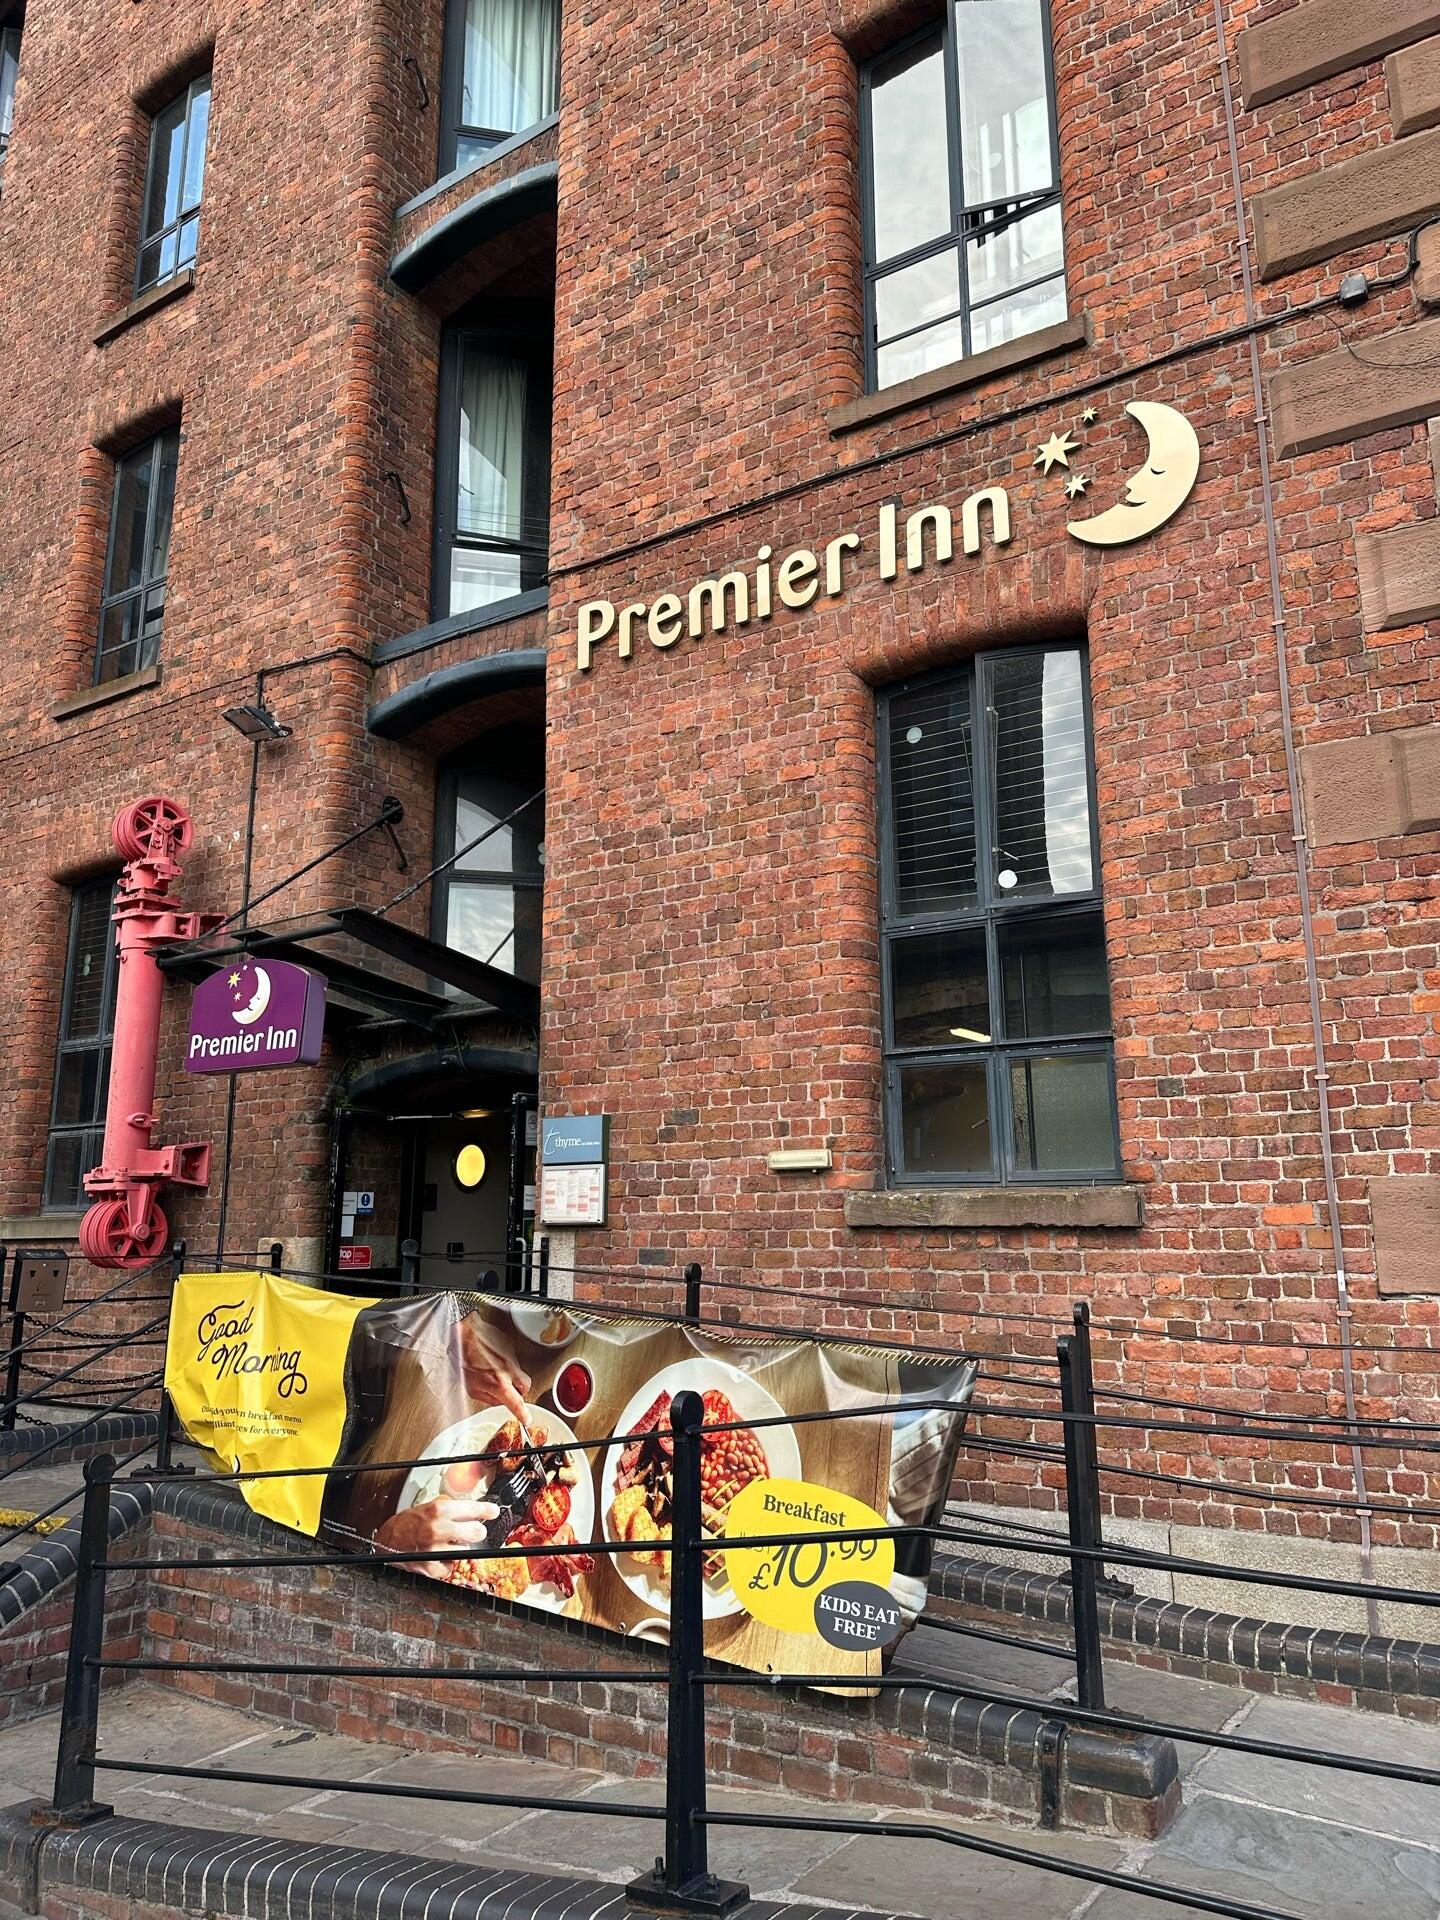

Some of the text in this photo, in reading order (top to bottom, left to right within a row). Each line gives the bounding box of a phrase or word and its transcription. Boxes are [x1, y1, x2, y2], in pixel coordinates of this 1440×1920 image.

[576, 486, 1013, 671] Premier Inn
[189, 1026, 297, 1059] Premier Inn
[555, 1136, 582, 1149] thyme
[197, 1299, 255, 1361] Good
[212, 1341, 308, 1398] Morning
[762, 1493, 847, 1528] Breakfast
[819, 1594, 900, 1625] KIDS EAT
